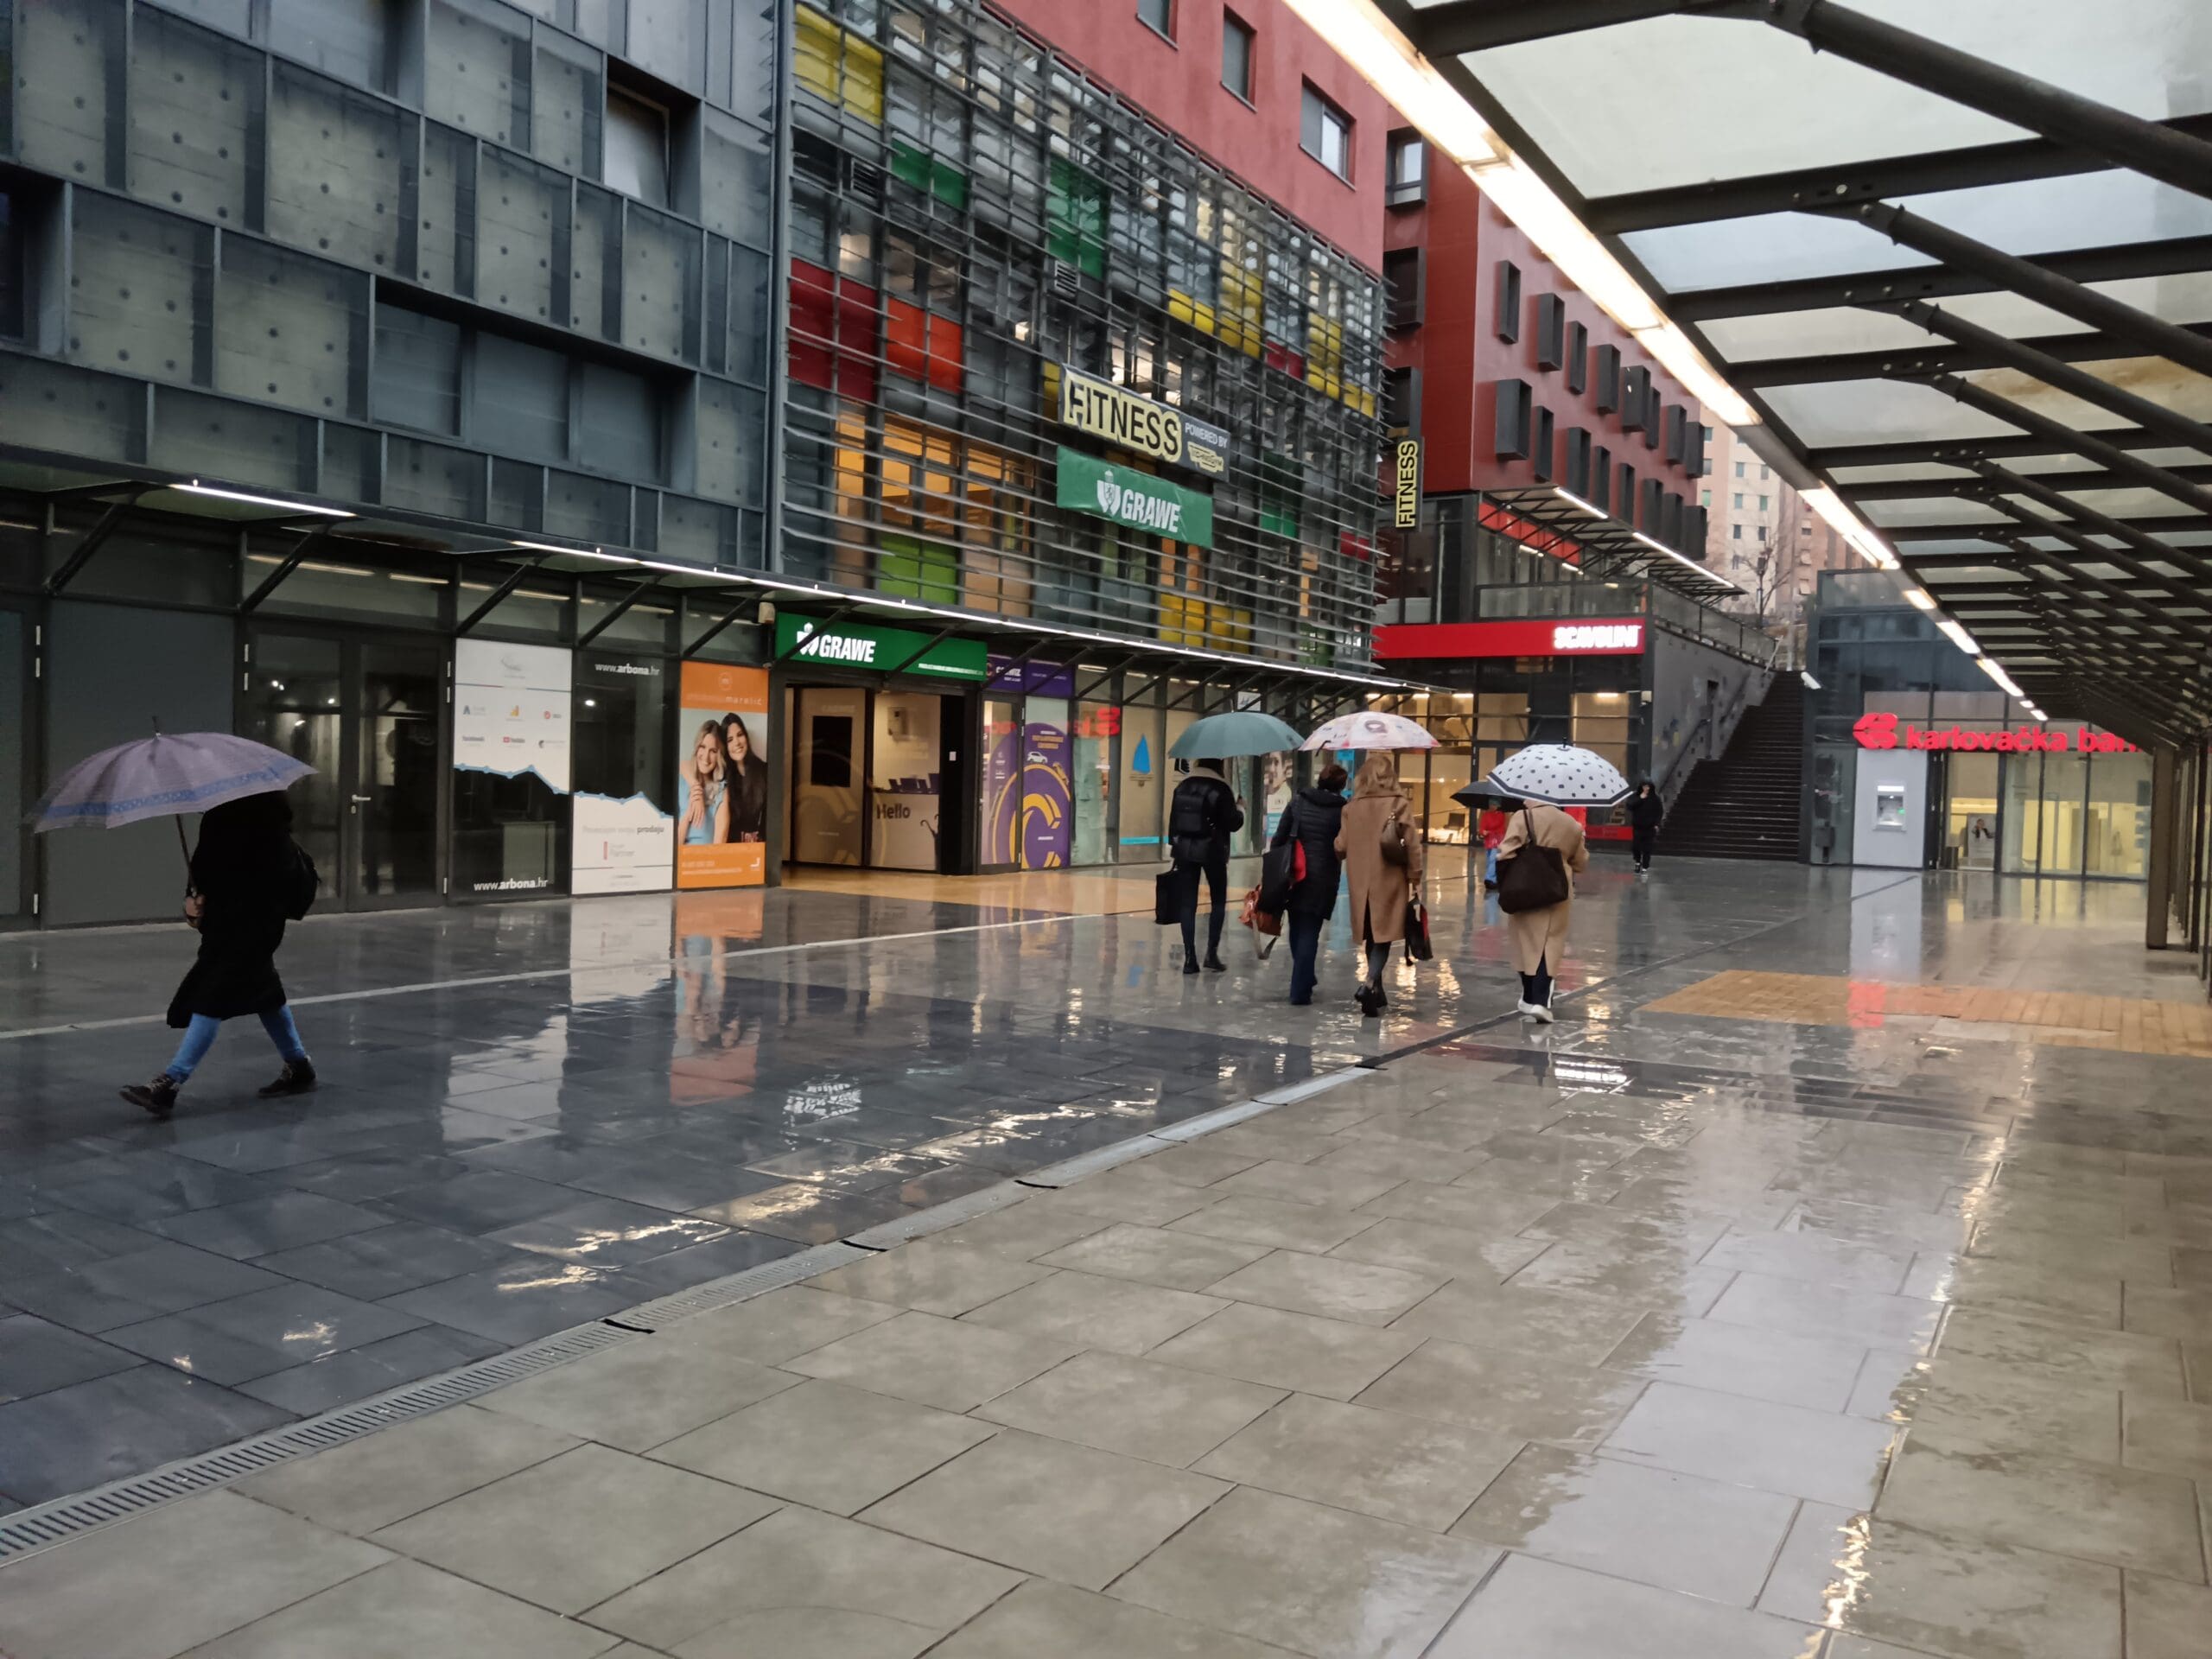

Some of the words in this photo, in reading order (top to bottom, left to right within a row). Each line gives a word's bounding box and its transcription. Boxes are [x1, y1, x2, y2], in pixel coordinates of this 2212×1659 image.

[1069, 379, 1179, 455] FITNESS
[1185, 422, 1217, 445] POWERED
[1217, 435, 1228, 448] BY
[1398, 442, 1415, 524] FITNESS
[1121, 488, 1182, 533] GRAWE
[819, 634, 876, 663] GRAWE
[594, 663, 660, 676] www.arbona.hr
[1906, 725, 2068, 752] karlovačka
[876, 803, 911, 819] Hello
[474, 877, 549, 892] www.arbona.hr
